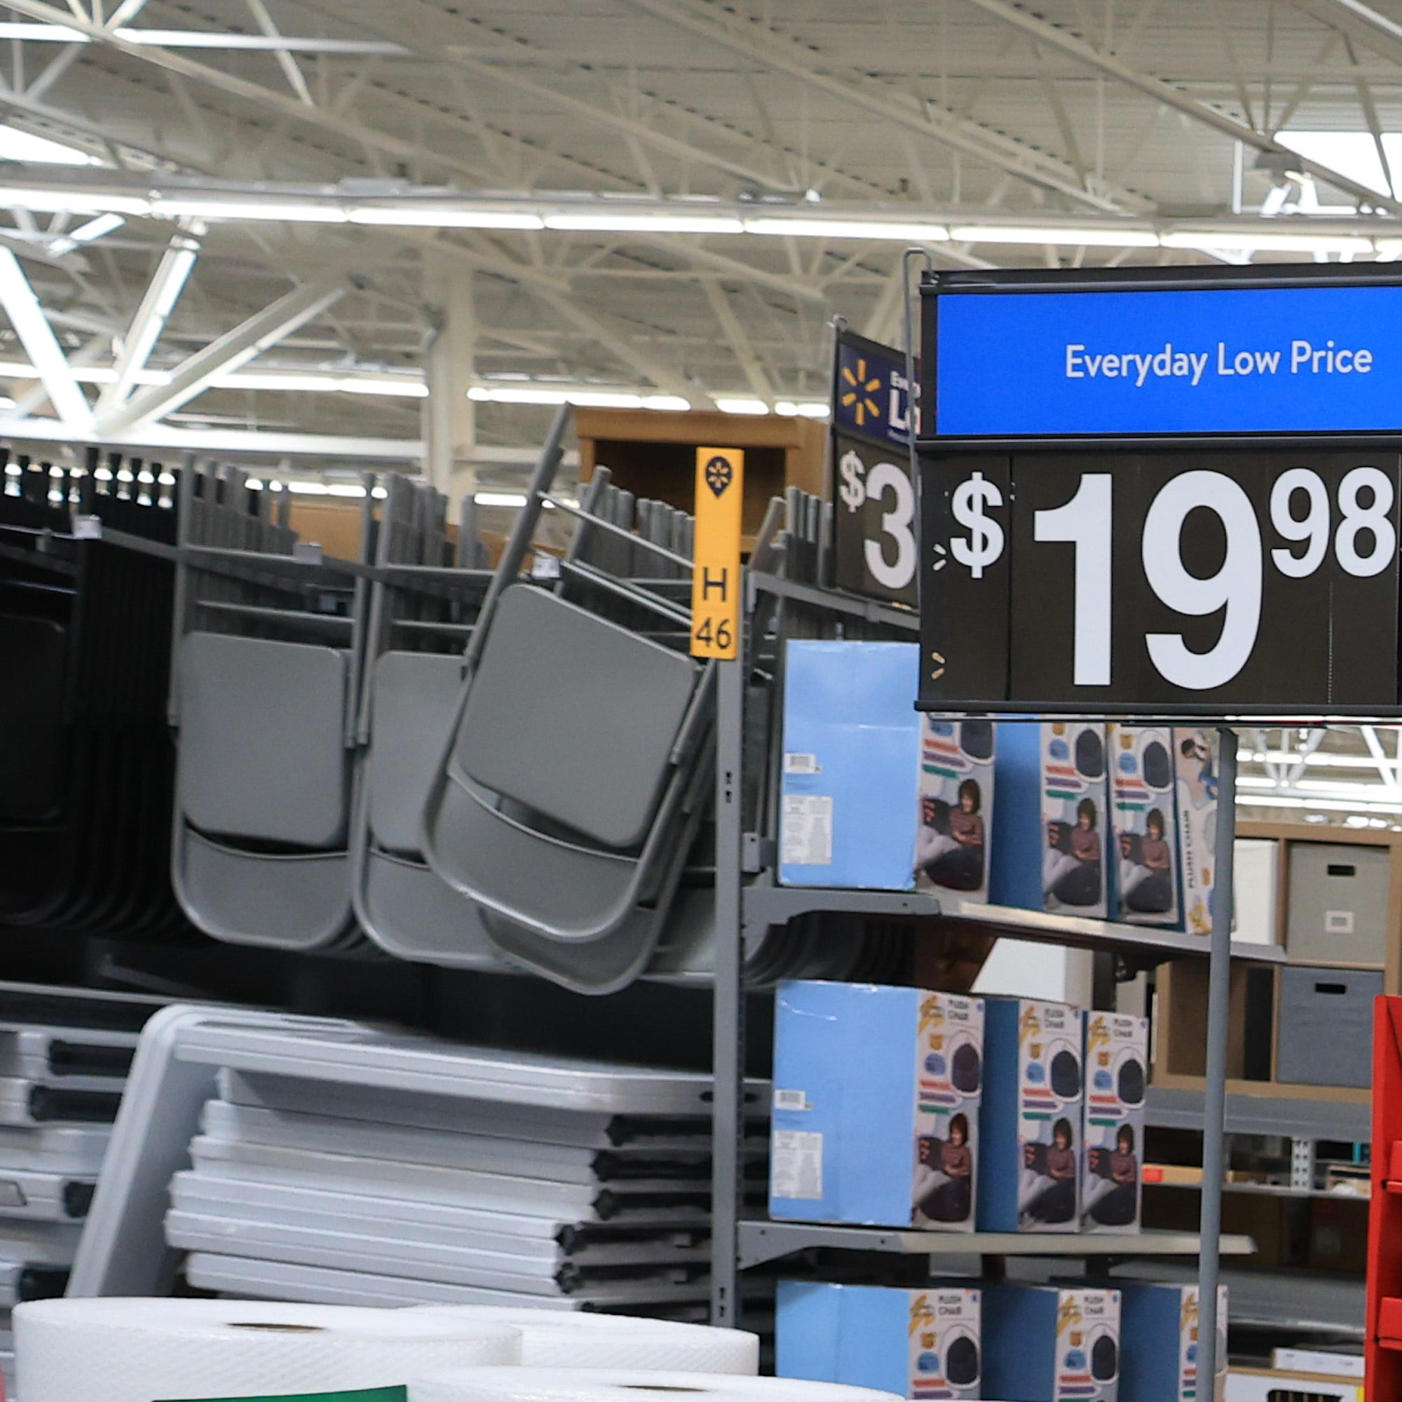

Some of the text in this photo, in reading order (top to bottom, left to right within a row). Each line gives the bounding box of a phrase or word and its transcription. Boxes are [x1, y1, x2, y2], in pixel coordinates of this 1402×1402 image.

[1066, 340, 1373, 387] Everyday Low Price
[703, 567, 728, 602] H
[694, 617, 733, 651] 46
